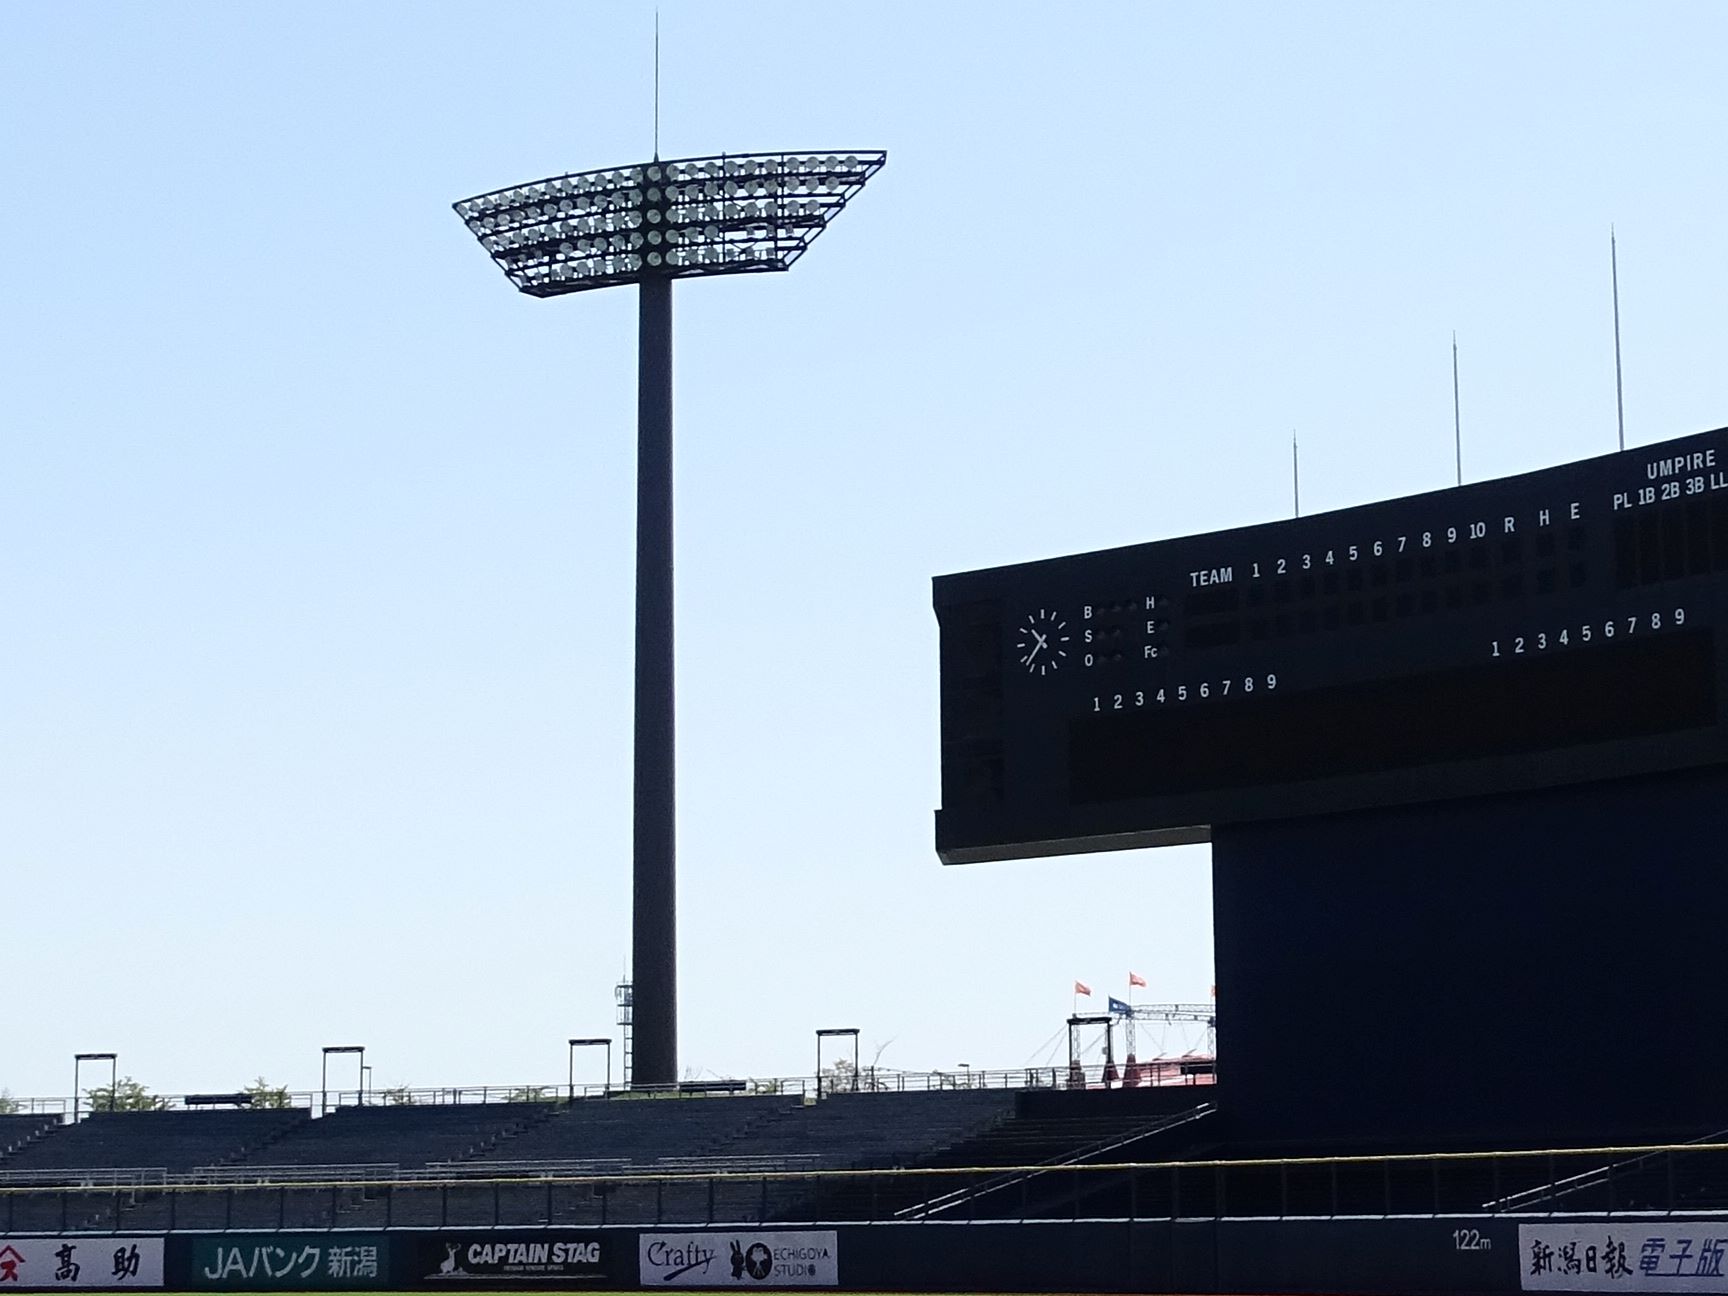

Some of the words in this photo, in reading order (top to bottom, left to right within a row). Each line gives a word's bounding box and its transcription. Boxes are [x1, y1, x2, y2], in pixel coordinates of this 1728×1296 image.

[1647, 449, 1716, 480] UMPIRE
[1613, 493, 1633, 511] PL
[1638, 487, 1656, 506] 1B
[1661, 481, 1680, 501] 2B
[1685, 476, 1705, 495] 3B
[1710, 471, 1728, 490] LL
[1189, 566, 1233, 587] TEAM
[1252, 563, 1260, 578] 1
[1277, 559, 1286, 574] 2
[1302, 554, 1311, 569] 3
[1325, 550, 1335, 565] 4
[1349, 546, 1358, 561] 5
[1373, 541, 1383, 557] 6
[1397, 536, 1407, 553] 7
[1422, 532, 1432, 548] 8
[1447, 527, 1457, 543] 9
[1469, 521, 1486, 540] 10
[1504, 516, 1515, 533] R
[1539, 509, 1550, 526] H
[1570, 502, 1581, 519] E
[1084, 605, 1093, 619] B
[1146, 596, 1155, 610] H
[1084, 629, 1093, 643] S
[1147, 620, 1155, 634] E
[1492, 641, 1500, 657] 1
[1514, 638, 1524, 653] 2
[1537, 633, 1547, 649] 3
[1559, 629, 1569, 645] 4
[1582, 625, 1591, 642] 5
[1604, 621, 1615, 637] 6
[1627, 617, 1637, 634] 7
[1651, 612, 1661, 629] 8
[1674, 608, 1685, 625] 9
[1093, 697, 1101, 712] 1
[1114, 694, 1123, 709] 2
[1135, 691, 1144, 706] 3
[1156, 688, 1166, 703] 4
[1178, 685, 1187, 701] 5
[1200, 682, 1209, 698] 6
[1222, 680, 1231, 695] 7
[1244, 677, 1254, 692] 8
[1266, 674, 1277, 690] 9
[468, 1243, 549, 1264] CAPTAIN
[552, 1242, 600, 1263] STAG
[773, 1247, 830, 1261] ECHIGOYA
[1453, 1229, 1491, 1250] 122m
[204, 1245, 320, 1279] JAバンク
[328, 1245, 378, 1277] 新潟
[647, 1241, 718, 1281] Crafty
[1530, 1235, 1633, 1279] 新潟日報
